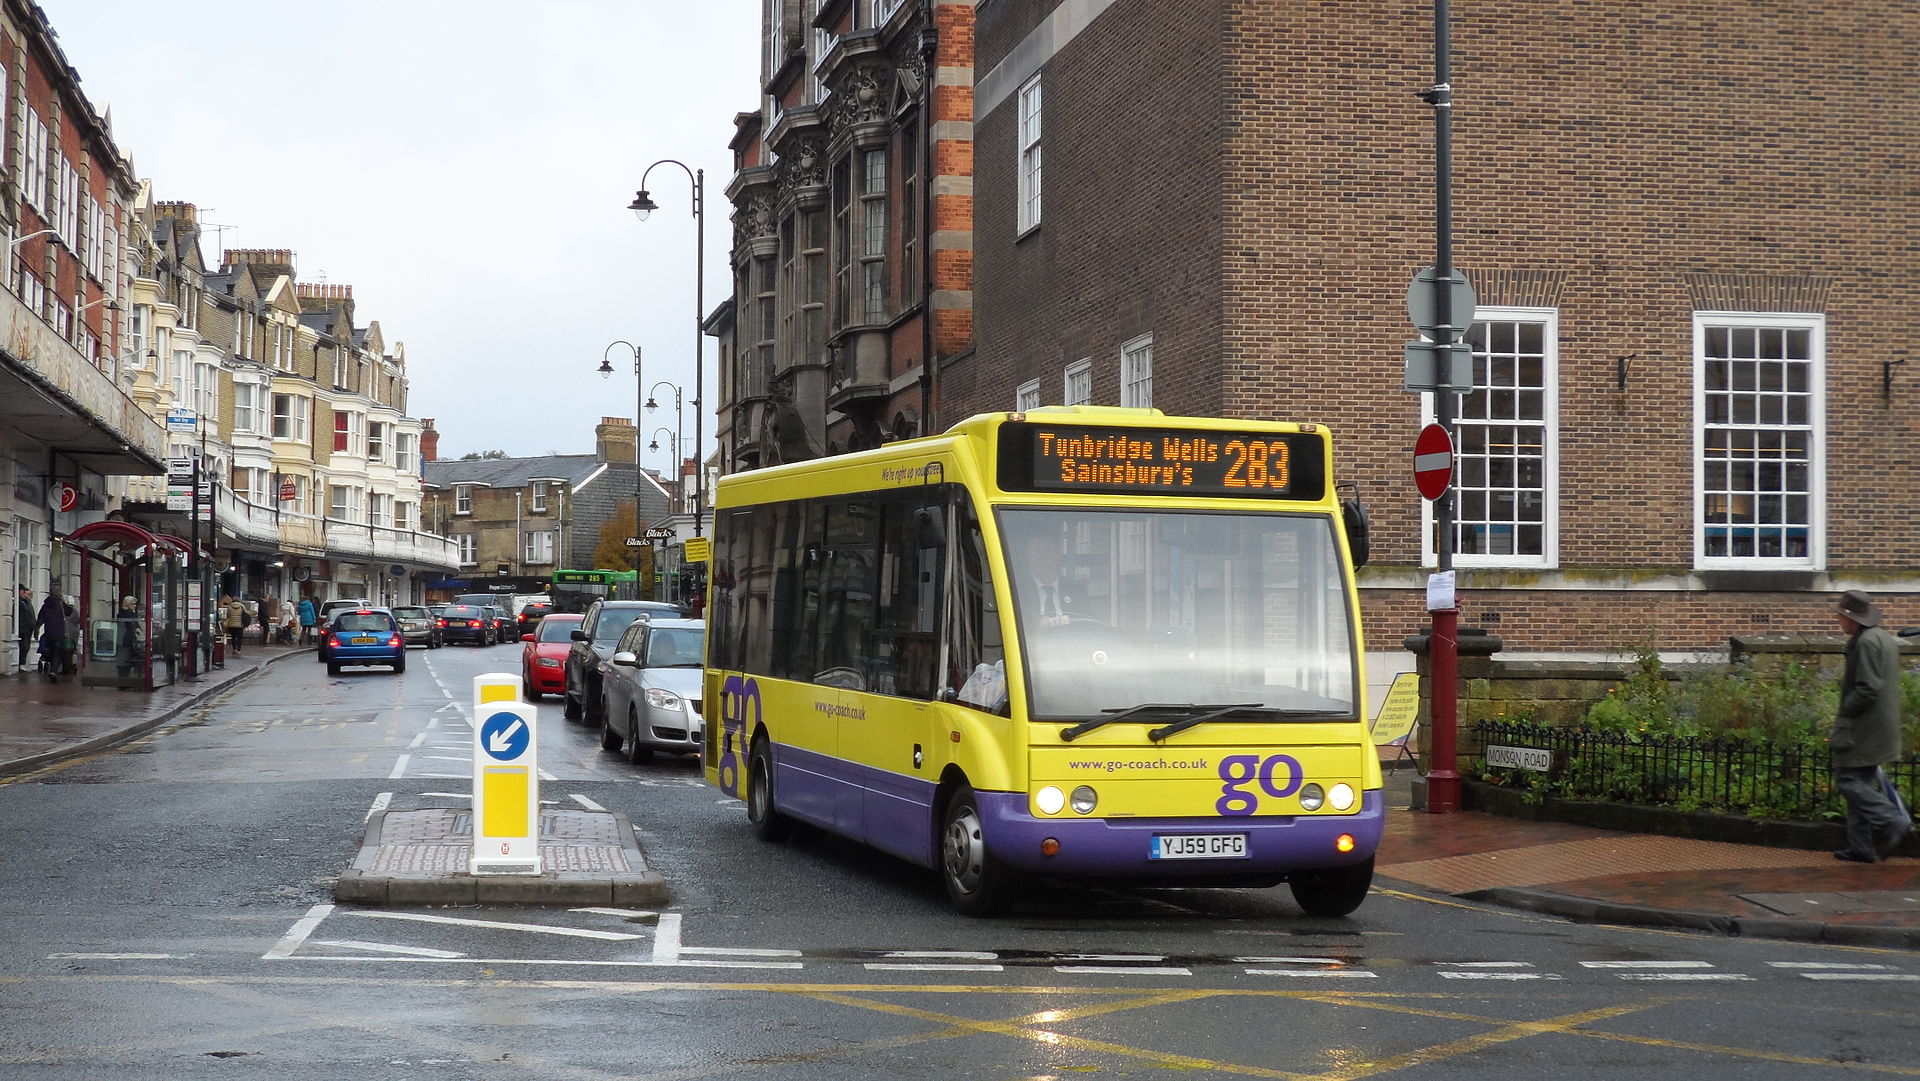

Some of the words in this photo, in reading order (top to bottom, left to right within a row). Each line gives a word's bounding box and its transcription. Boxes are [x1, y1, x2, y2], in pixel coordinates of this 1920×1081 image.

[1039, 433, 1153, 460] Tunbridge
[1163, 437, 1218, 462] Wells
[1224, 440, 1289, 489] 283
[209, 471, 218, 479] M
[895, 465, 906, 484] right
[907, 467, 914, 481] up
[1061, 458, 1194, 486] Sainsbury's
[626, 537, 651, 546] Blacks
[646, 529, 672, 538] Blacks
[588, 574, 600, 582] 285
[815, 701, 866, 721] www.go-coach.co.uk
[1069, 758, 1208, 773] www.go-coach.co.uk
[1488, 749, 1522, 764] MONSON
[1524, 752, 1549, 768] ROAD
[1215, 754, 1303, 817] go
[1163, 837, 1206, 856] YJ59
[1211, 836, 1243, 854] GFG
